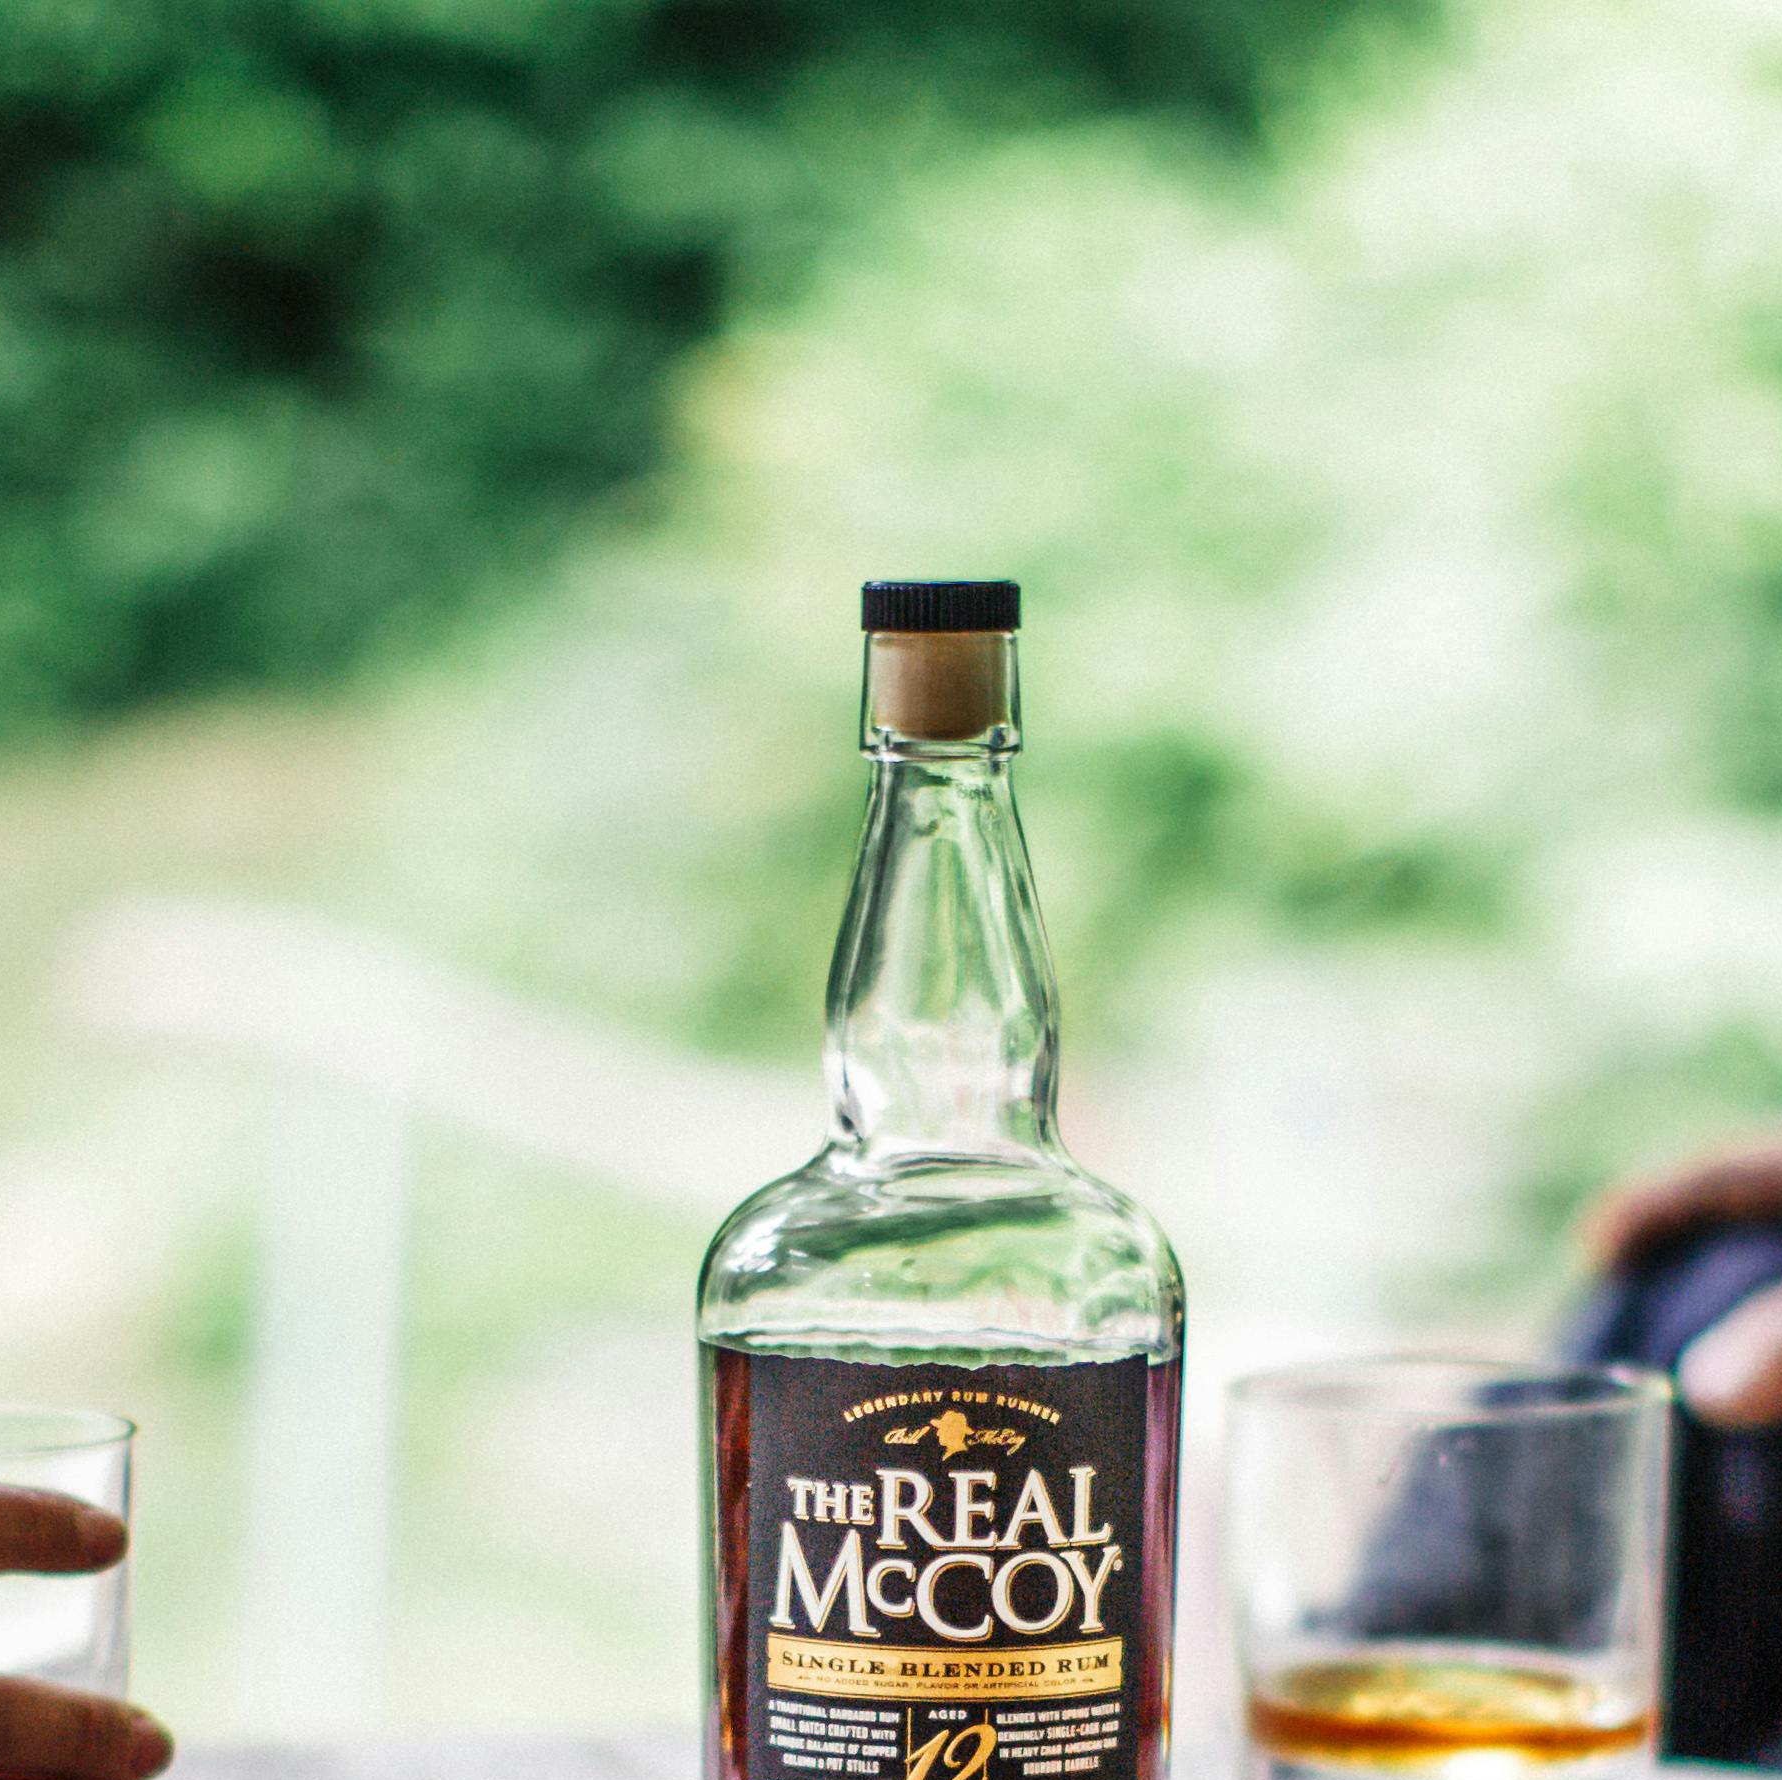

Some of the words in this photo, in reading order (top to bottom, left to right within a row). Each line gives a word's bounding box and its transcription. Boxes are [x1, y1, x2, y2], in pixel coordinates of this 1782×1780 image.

[842, 1391, 943, 1423] LEGENDARY
[951, 1391, 989, 1403] RUM
[997, 1395, 1062, 1426] RUNNER
[787, 1478, 875, 1525] THE
[876, 1467, 1113, 1551] REAL
[782, 1651, 886, 1676] SINGLE
[900, 1661, 1046, 1678] BLENDED
[1057, 1653, 1110, 1673] RUM
[835, 1677, 869, 1687] ADDED
[928, 1709, 967, 1720] AGED
[1038, 1711, 1061, 1722] WITH
[770, 1716, 797, 1732] SMALL
[827, 1724, 869, 1739] CRAFTED
[870, 1730, 897, 1740] WITH
[846, 1760, 880, 1774] STILLS
